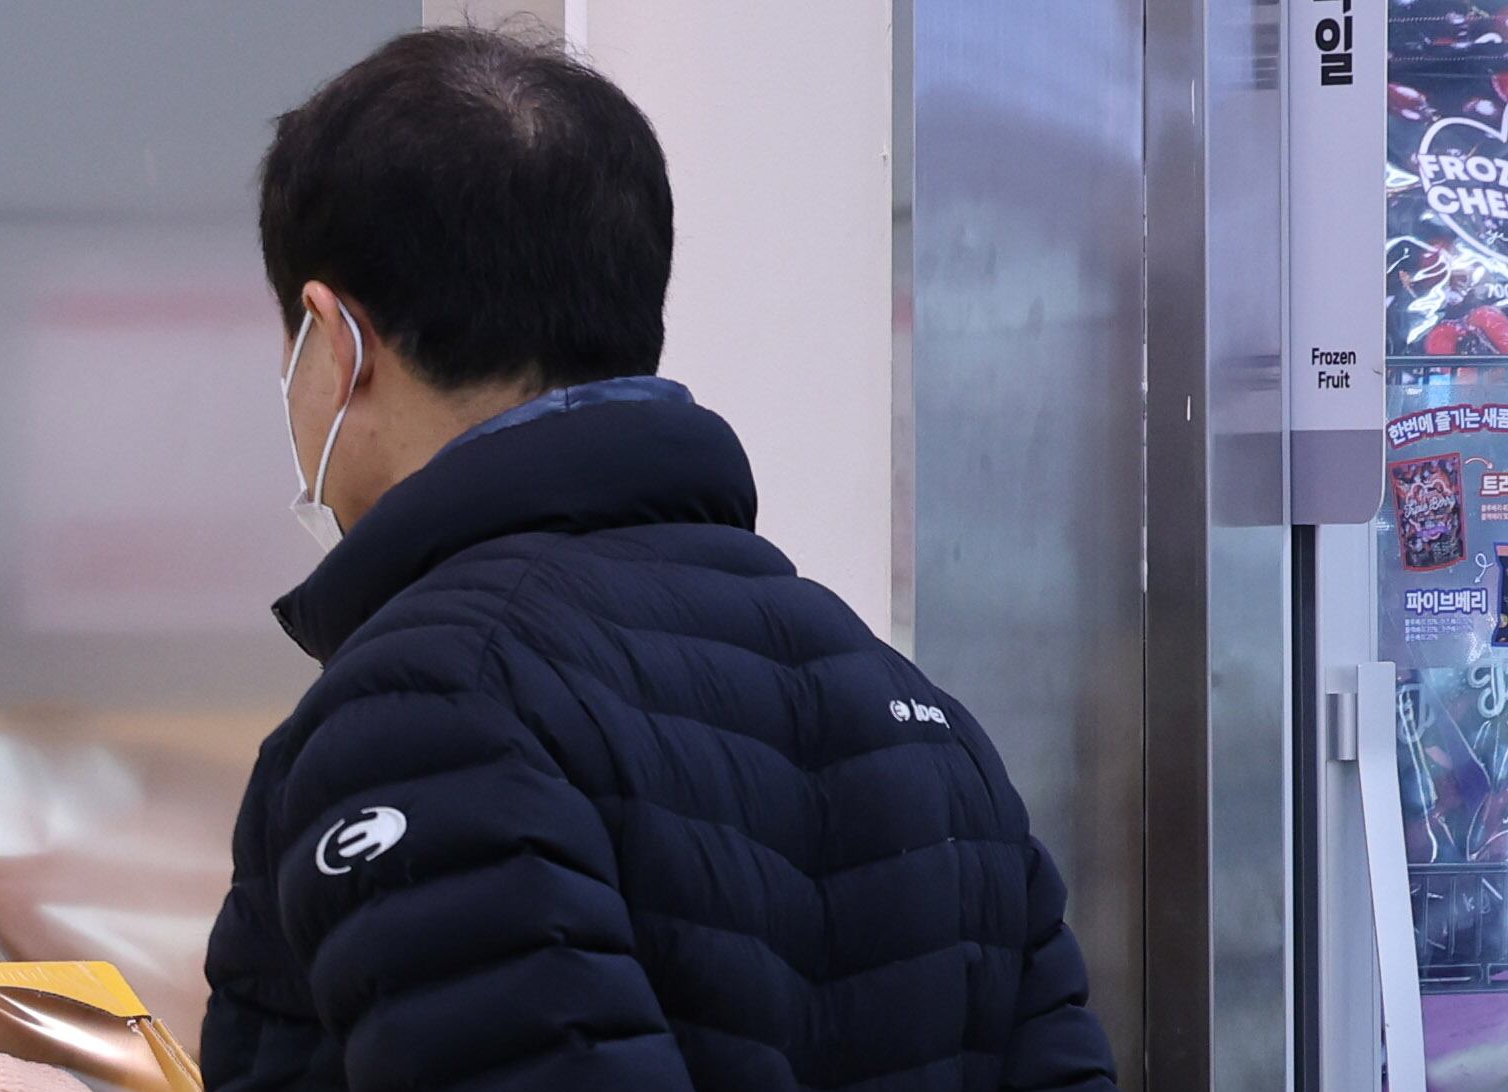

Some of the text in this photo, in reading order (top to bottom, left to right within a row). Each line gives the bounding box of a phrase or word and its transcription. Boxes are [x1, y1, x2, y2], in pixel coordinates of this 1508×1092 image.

[1427, 184, 1508, 218] CHE
[1311, 348, 1357, 365] Frozen
[1318, 370, 1350, 389] Fruit
[1387, 412, 1434, 446] 한번에
[1434, 408, 1481, 432] 즐기는
[1406, 590, 1487, 614] 파이브베리
